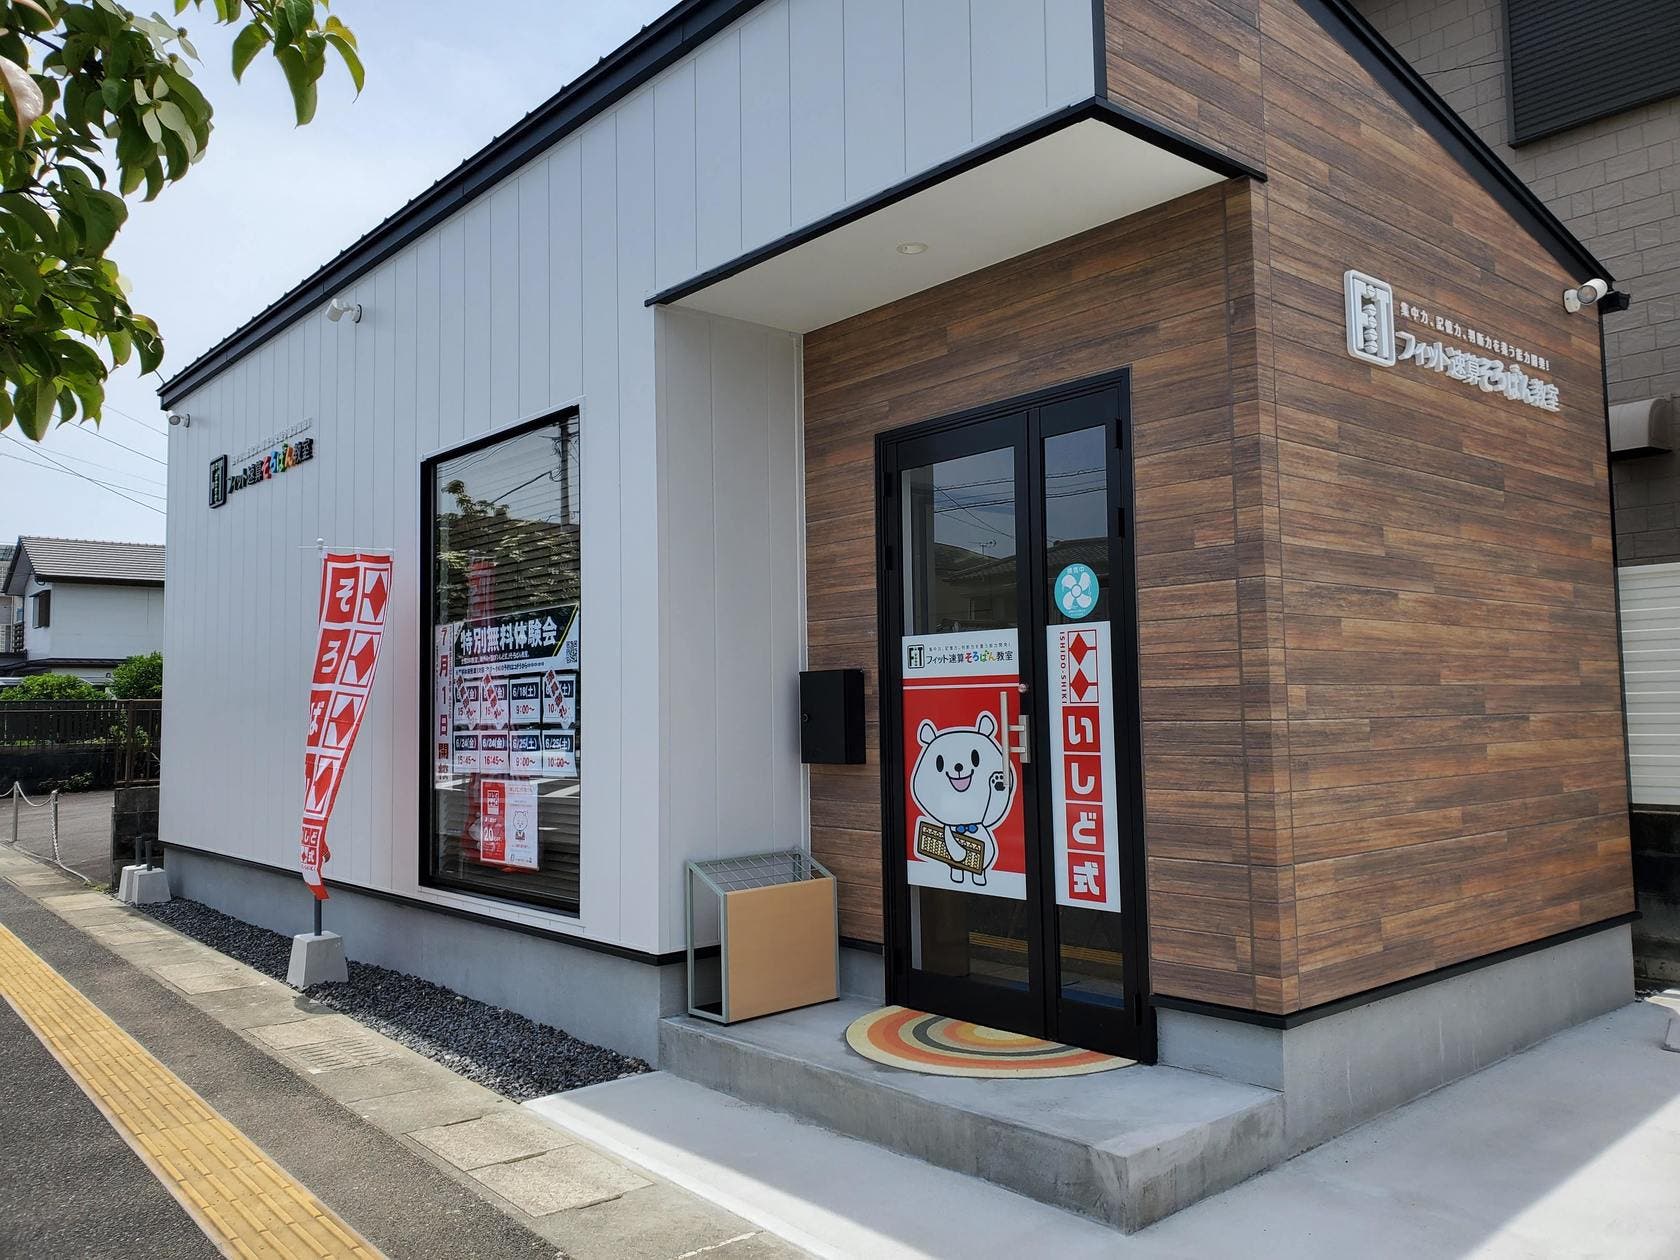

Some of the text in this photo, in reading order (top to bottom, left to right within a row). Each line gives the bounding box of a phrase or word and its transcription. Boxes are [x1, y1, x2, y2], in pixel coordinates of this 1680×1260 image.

[460, 616, 558, 656] 特別無料体験会
[926, 650, 1013, 664] フィット速算そろばん教室
[1068, 715, 1101, 896] いしど式
